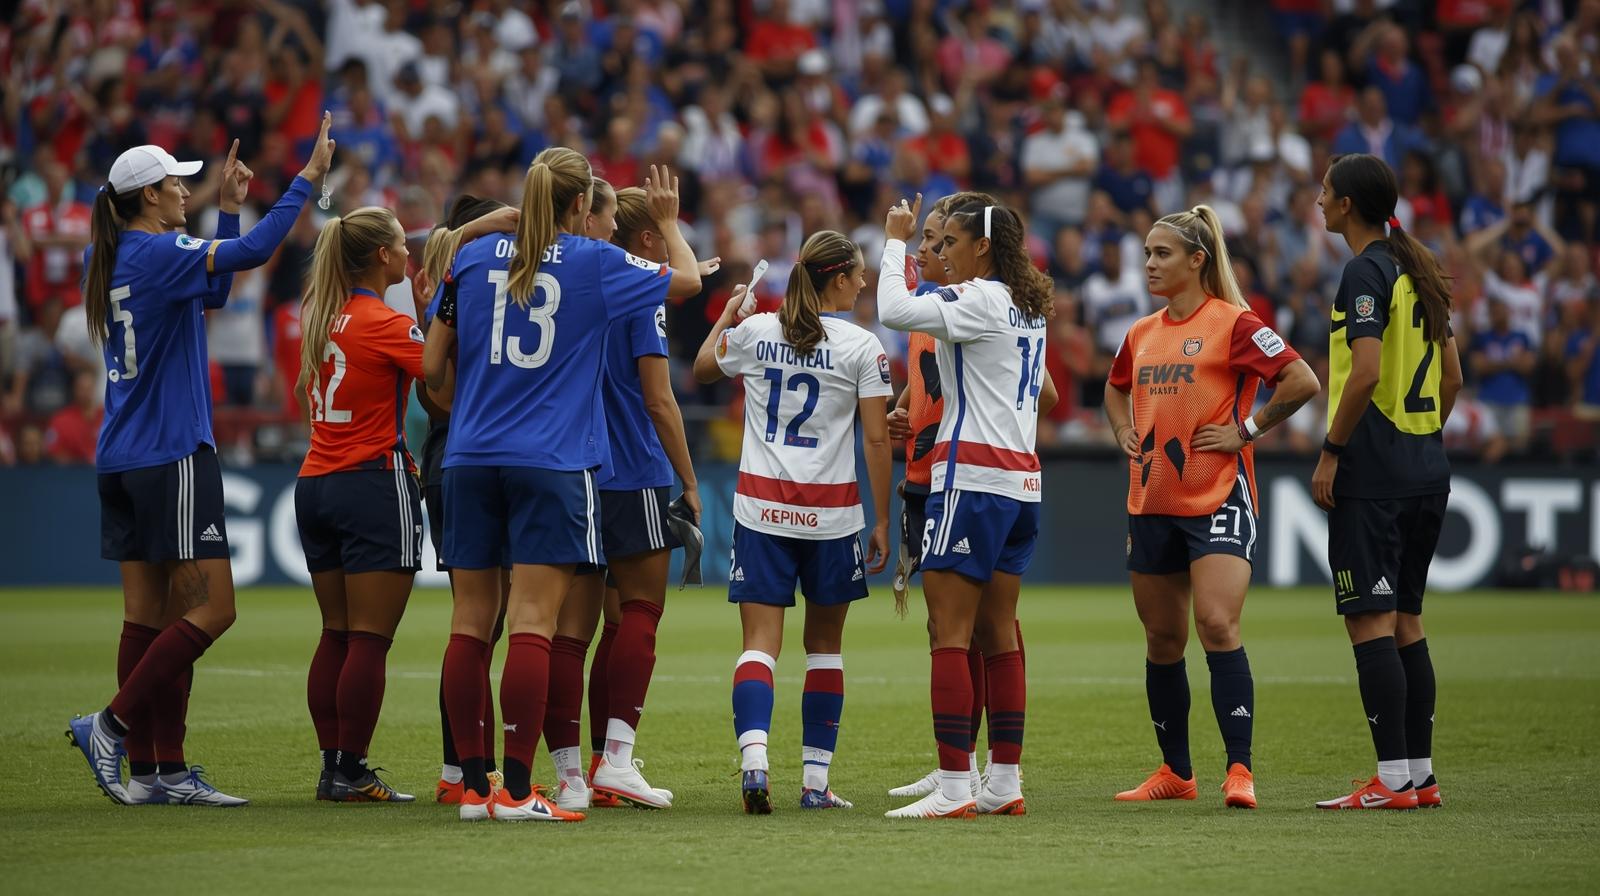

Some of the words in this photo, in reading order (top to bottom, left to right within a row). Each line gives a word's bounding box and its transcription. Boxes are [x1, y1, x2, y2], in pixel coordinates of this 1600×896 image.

[487, 269, 562, 369] 13
[1403, 300, 1437, 414] 2
[764, 368, 820, 449] 12
[1016, 336, 1044, 413] 14
[1137, 363, 1196, 385] EWR
[760, 508, 819, 528] KEPING
[1267, 474, 1600, 593] NOT
